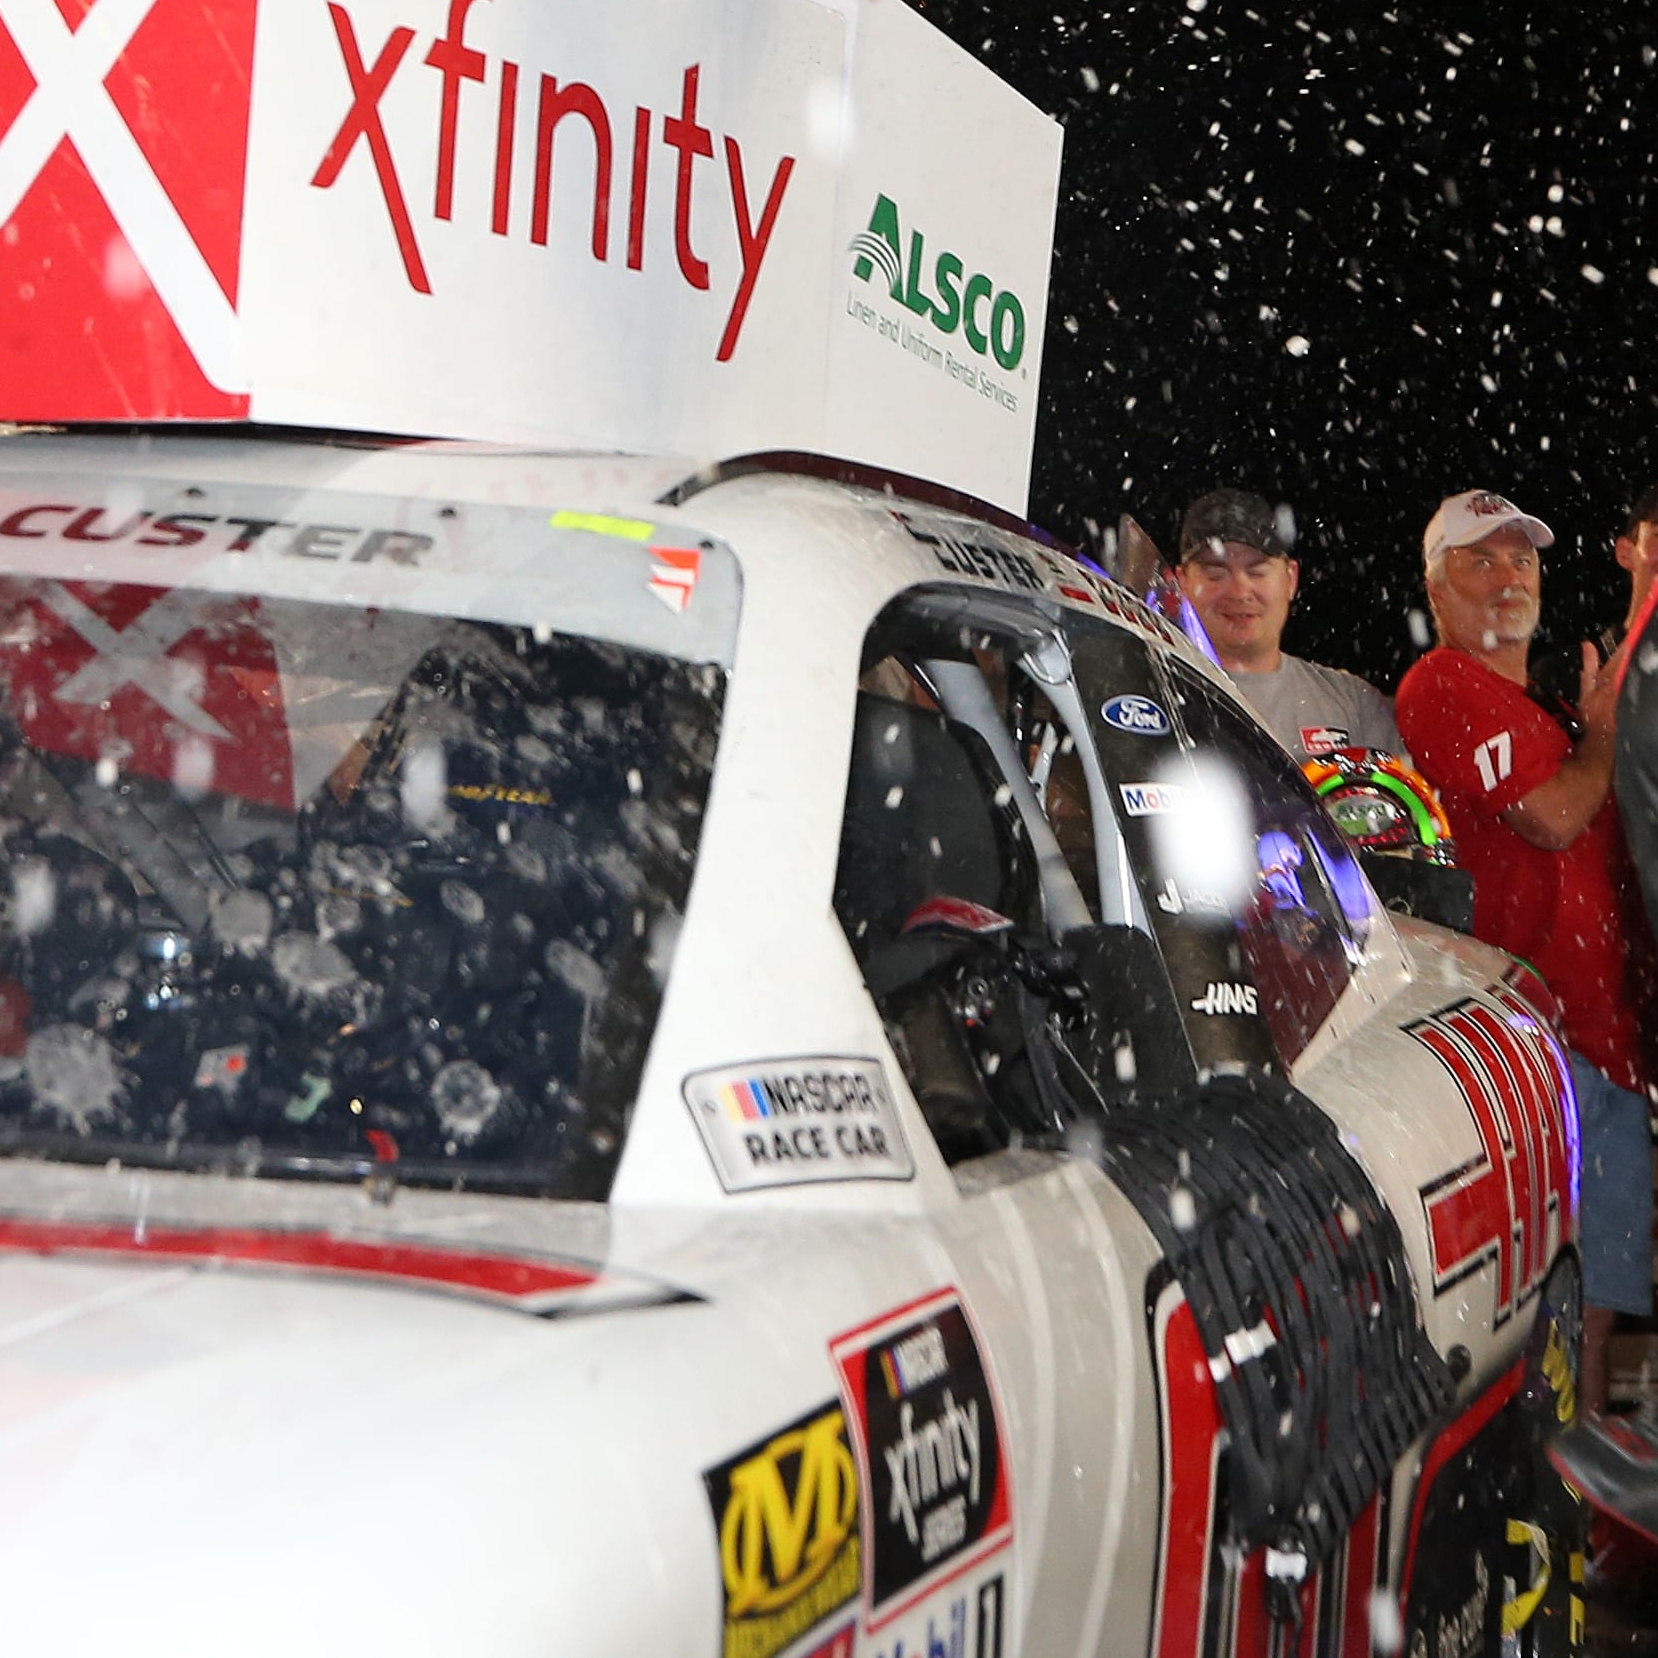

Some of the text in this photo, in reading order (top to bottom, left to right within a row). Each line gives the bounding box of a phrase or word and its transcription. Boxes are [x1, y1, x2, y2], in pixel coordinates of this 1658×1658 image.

[848, 193, 1025, 370] ALSCO
[846, 290, 1018, 412] Linen and Uniform Rental Services
[1118, 699, 1162, 730] Ford
[1473, 730, 1513, 792] 17
[1191, 982, 1259, 1016] HAAS
[762, 1073, 879, 1119] NASCAR
[744, 1125, 892, 1166] RACE CAR
[884, 1387, 981, 1546] xfinity
